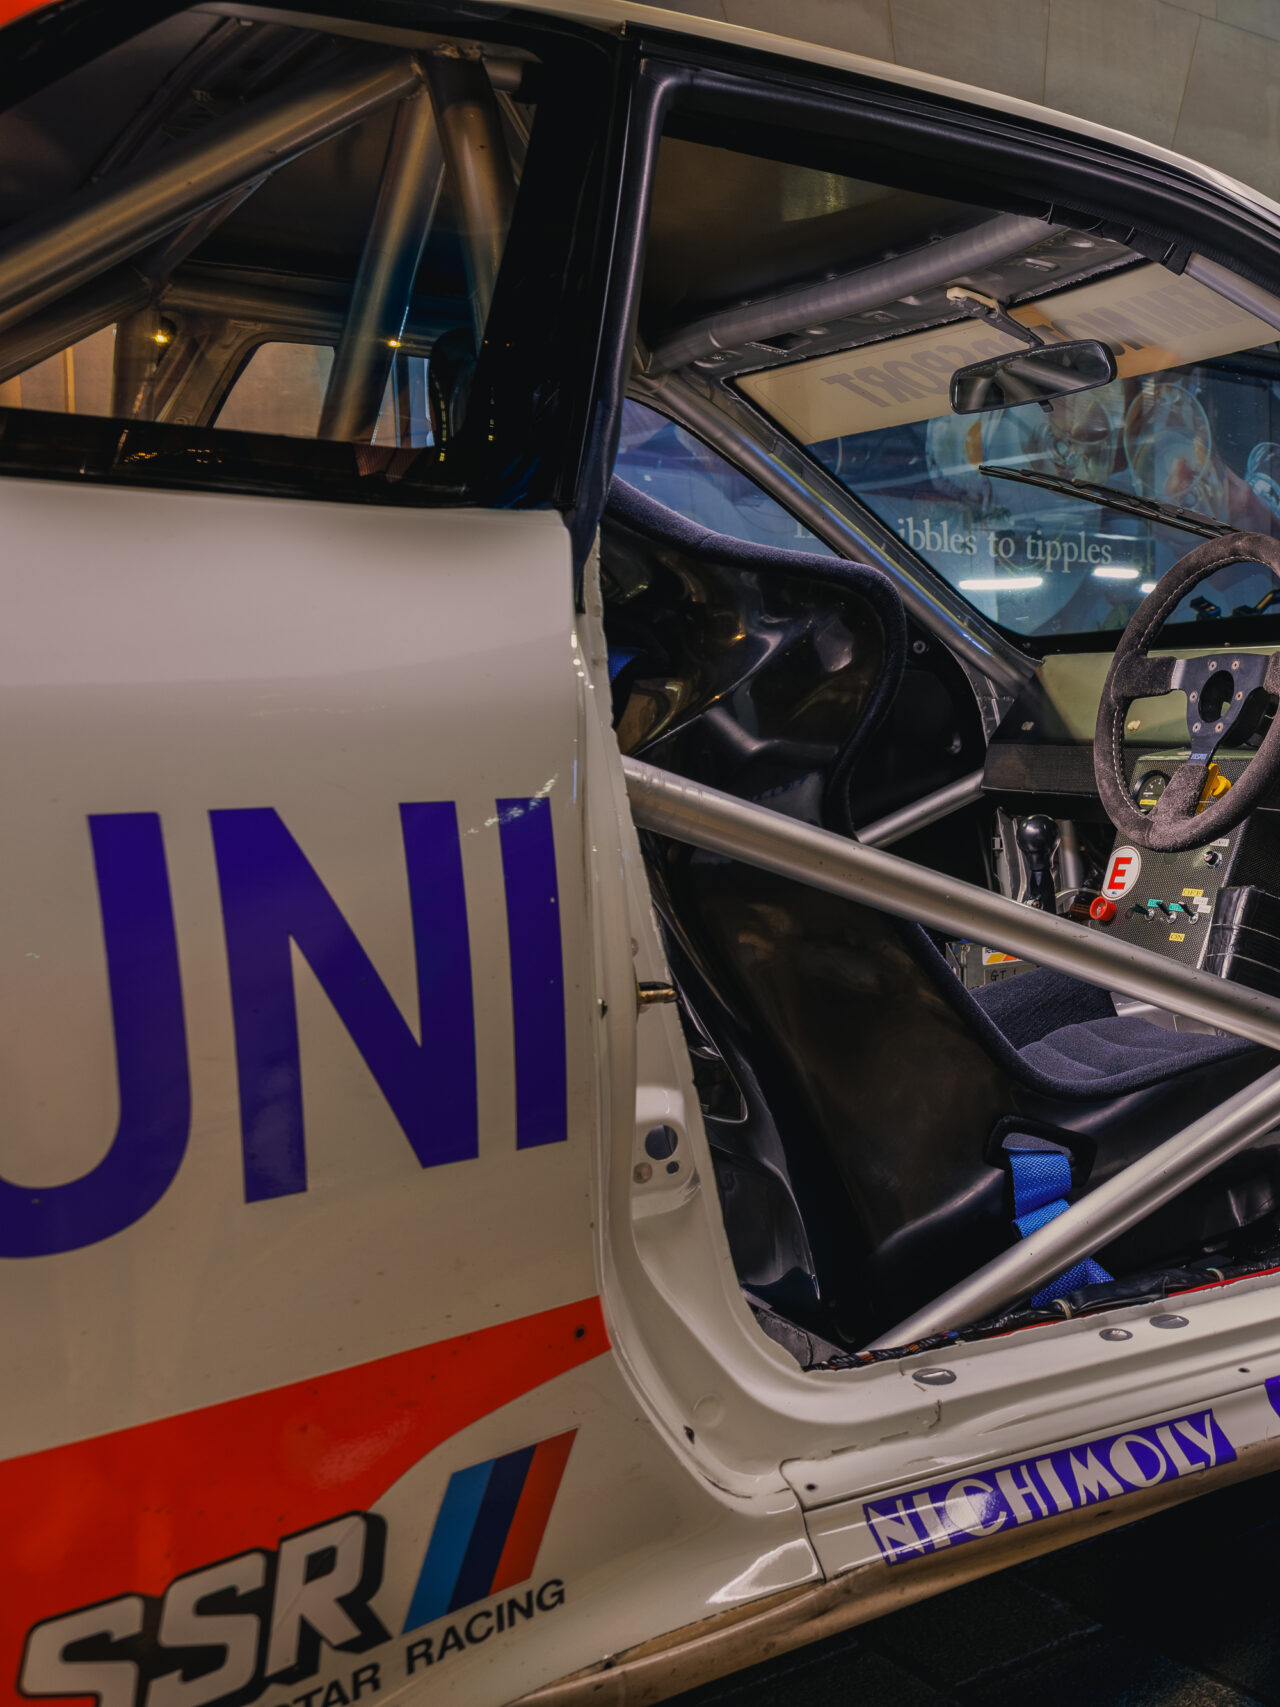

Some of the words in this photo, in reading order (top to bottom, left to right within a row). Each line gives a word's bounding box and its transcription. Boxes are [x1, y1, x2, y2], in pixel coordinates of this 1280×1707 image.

[898, 517, 977, 556] ibbles
[987, 531, 1015, 558] to
[1025, 530, 1112, 573] tipples
[1107, 857, 1132, 889] E
[1170, 933, 1184, 941] ON
[0, 797, 567, 1258] UNI
[867, 1413, 1216, 1563] NICHIMOLY
[16, 1510, 393, 1707] SSR
[274, 1662, 381, 1707] TAR
[405, 1578, 566, 1676] RACING
